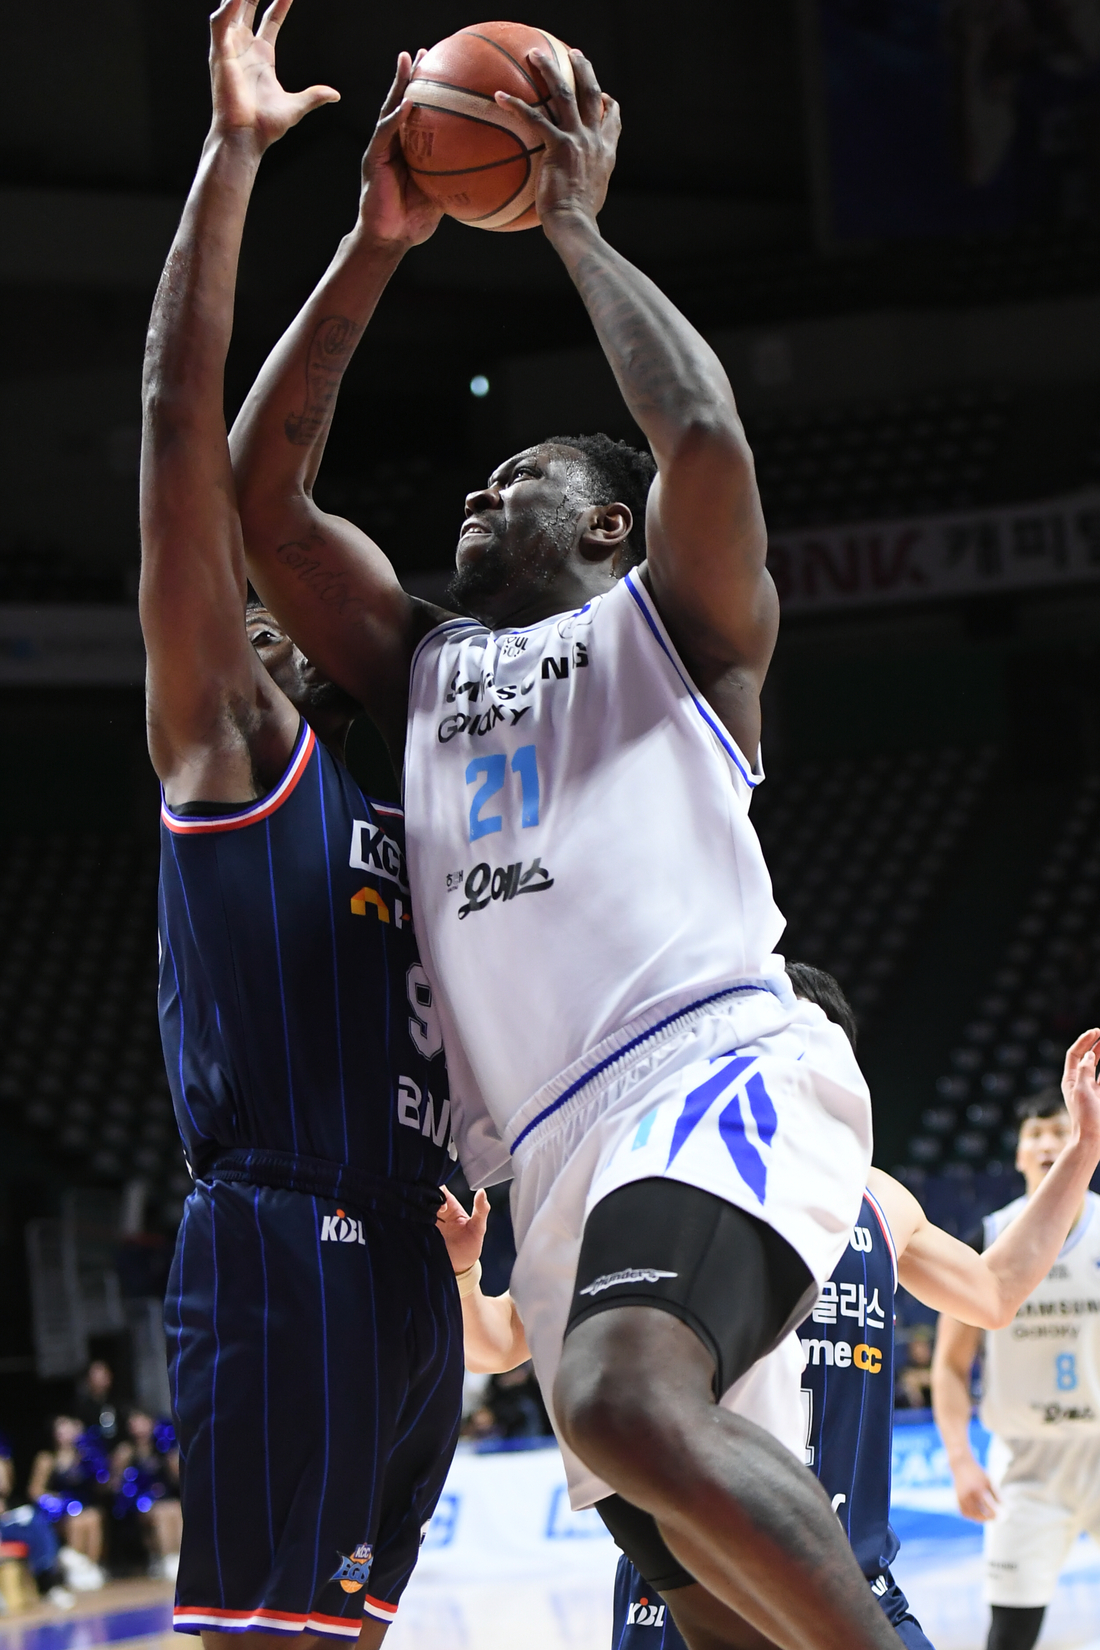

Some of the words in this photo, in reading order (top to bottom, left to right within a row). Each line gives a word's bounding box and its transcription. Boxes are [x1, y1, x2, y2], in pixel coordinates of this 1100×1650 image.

[465, 744, 540, 843] 21
[457, 857, 555, 921] 오예스
[320, 1212, 366, 1246] KBL
[812, 1281, 885, 1329] 글라스
[1055, 1353, 1078, 1391] 8
[626, 1601, 666, 1627] KBL
